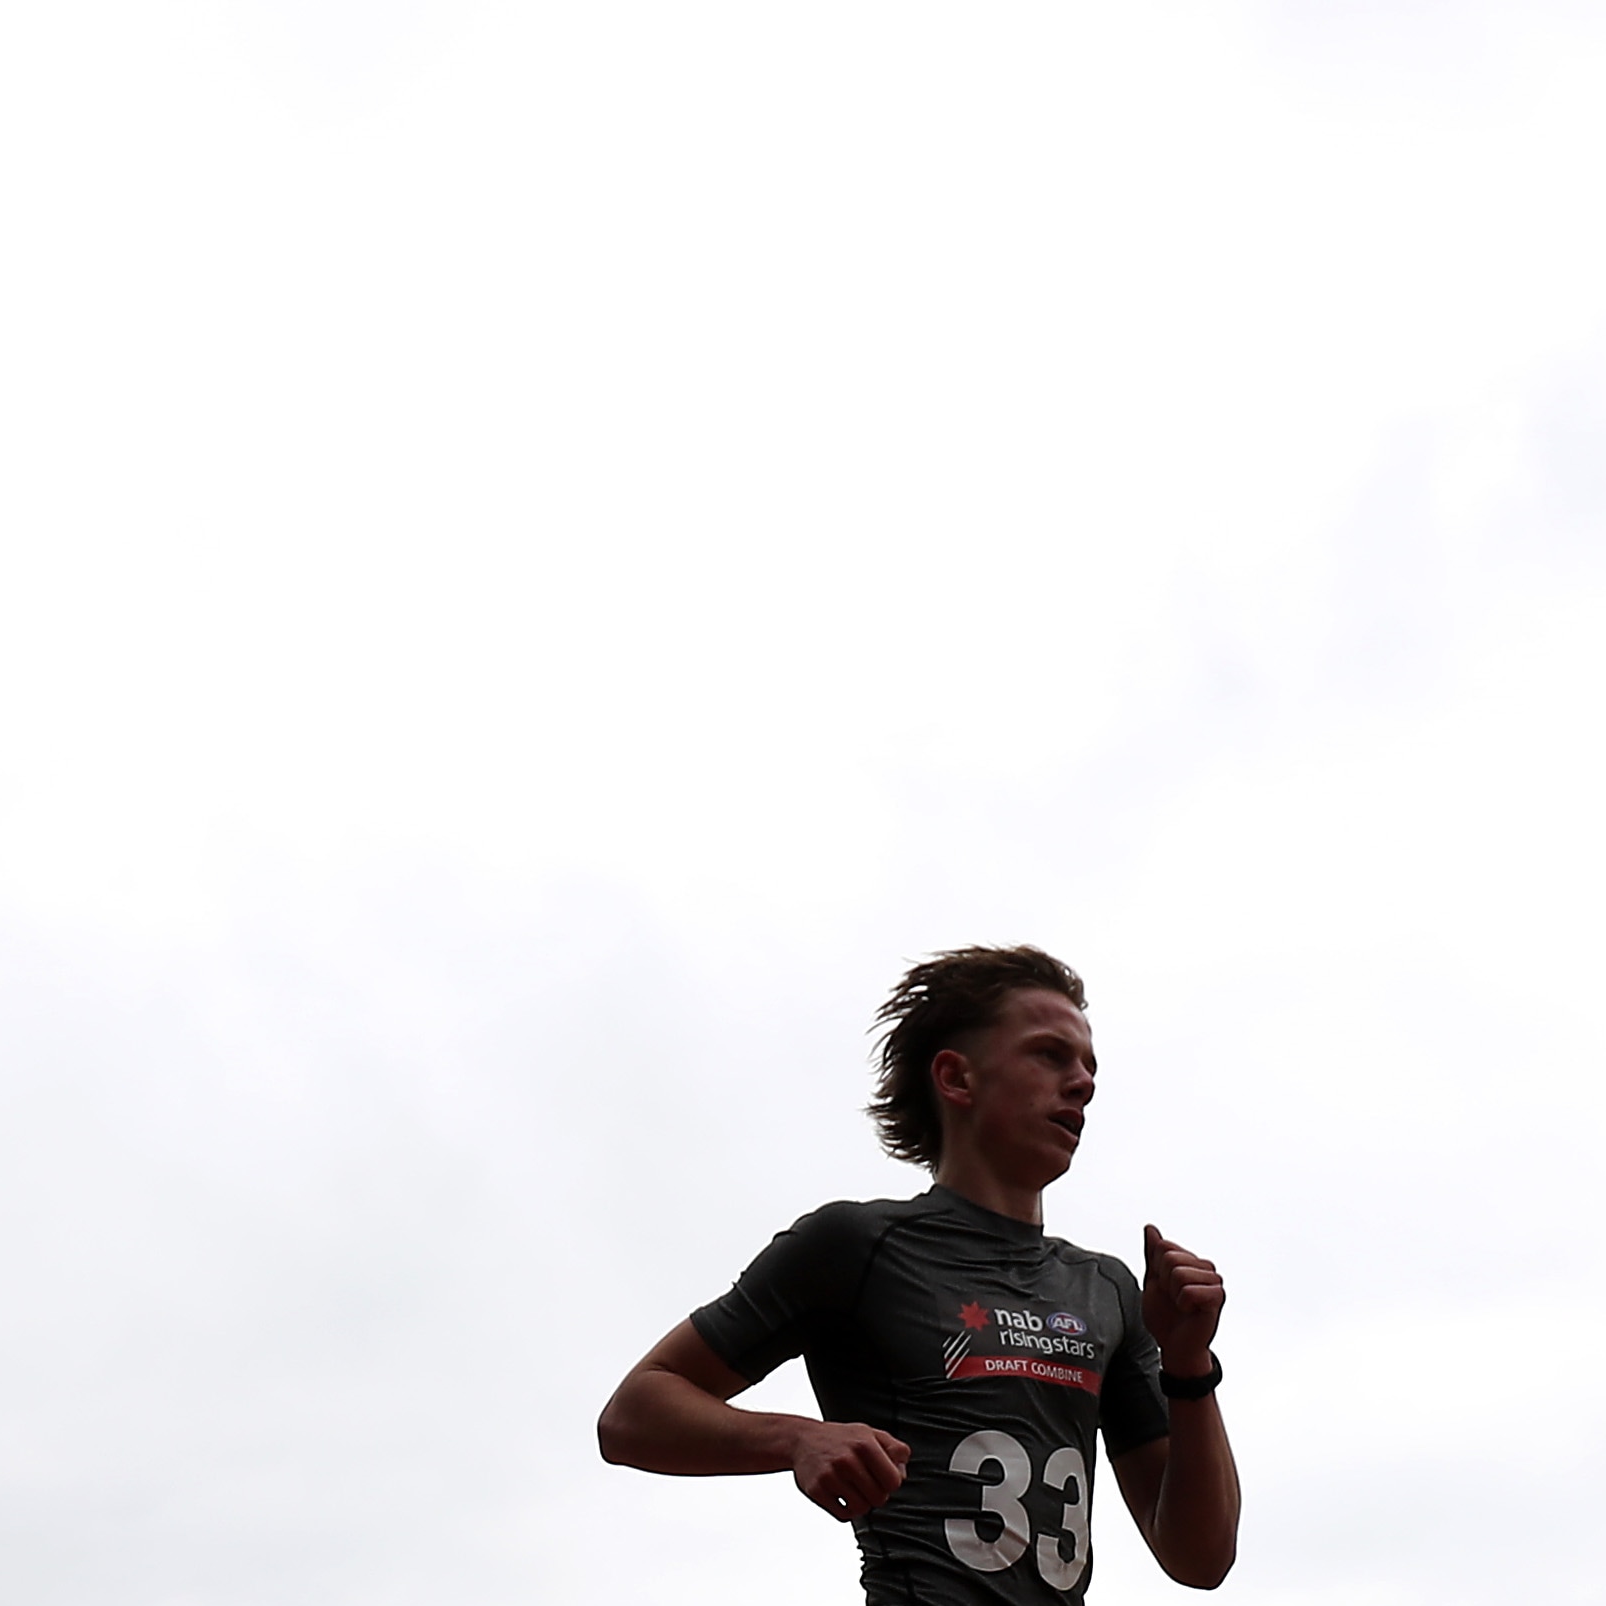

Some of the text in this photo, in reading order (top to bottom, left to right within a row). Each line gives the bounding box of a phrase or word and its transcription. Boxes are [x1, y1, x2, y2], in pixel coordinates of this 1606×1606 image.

[994, 1308, 1083, 1332] nab AFL
[985, 1359, 1084, 1384] DRAFT COMBINE
[945, 1430, 1089, 1591] 33
